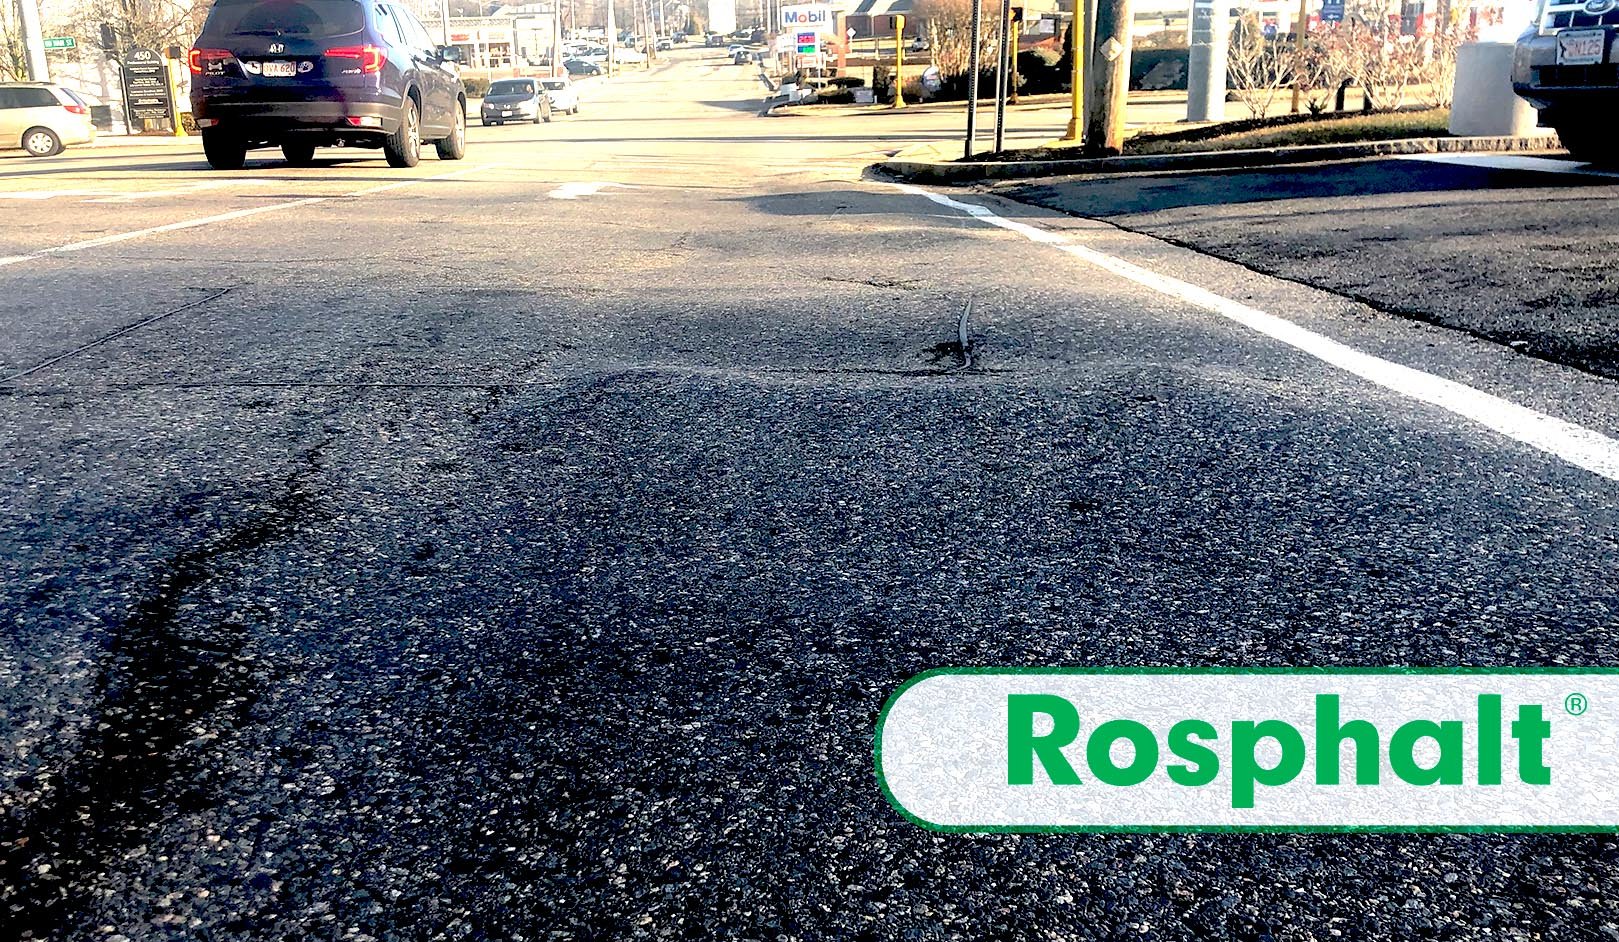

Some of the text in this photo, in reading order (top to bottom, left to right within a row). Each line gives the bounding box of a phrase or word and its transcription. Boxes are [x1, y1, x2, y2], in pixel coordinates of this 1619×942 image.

[785, 10, 825, 23] Mobil
[134, 51, 152, 60] 450
[280, 63, 295, 73] 620
